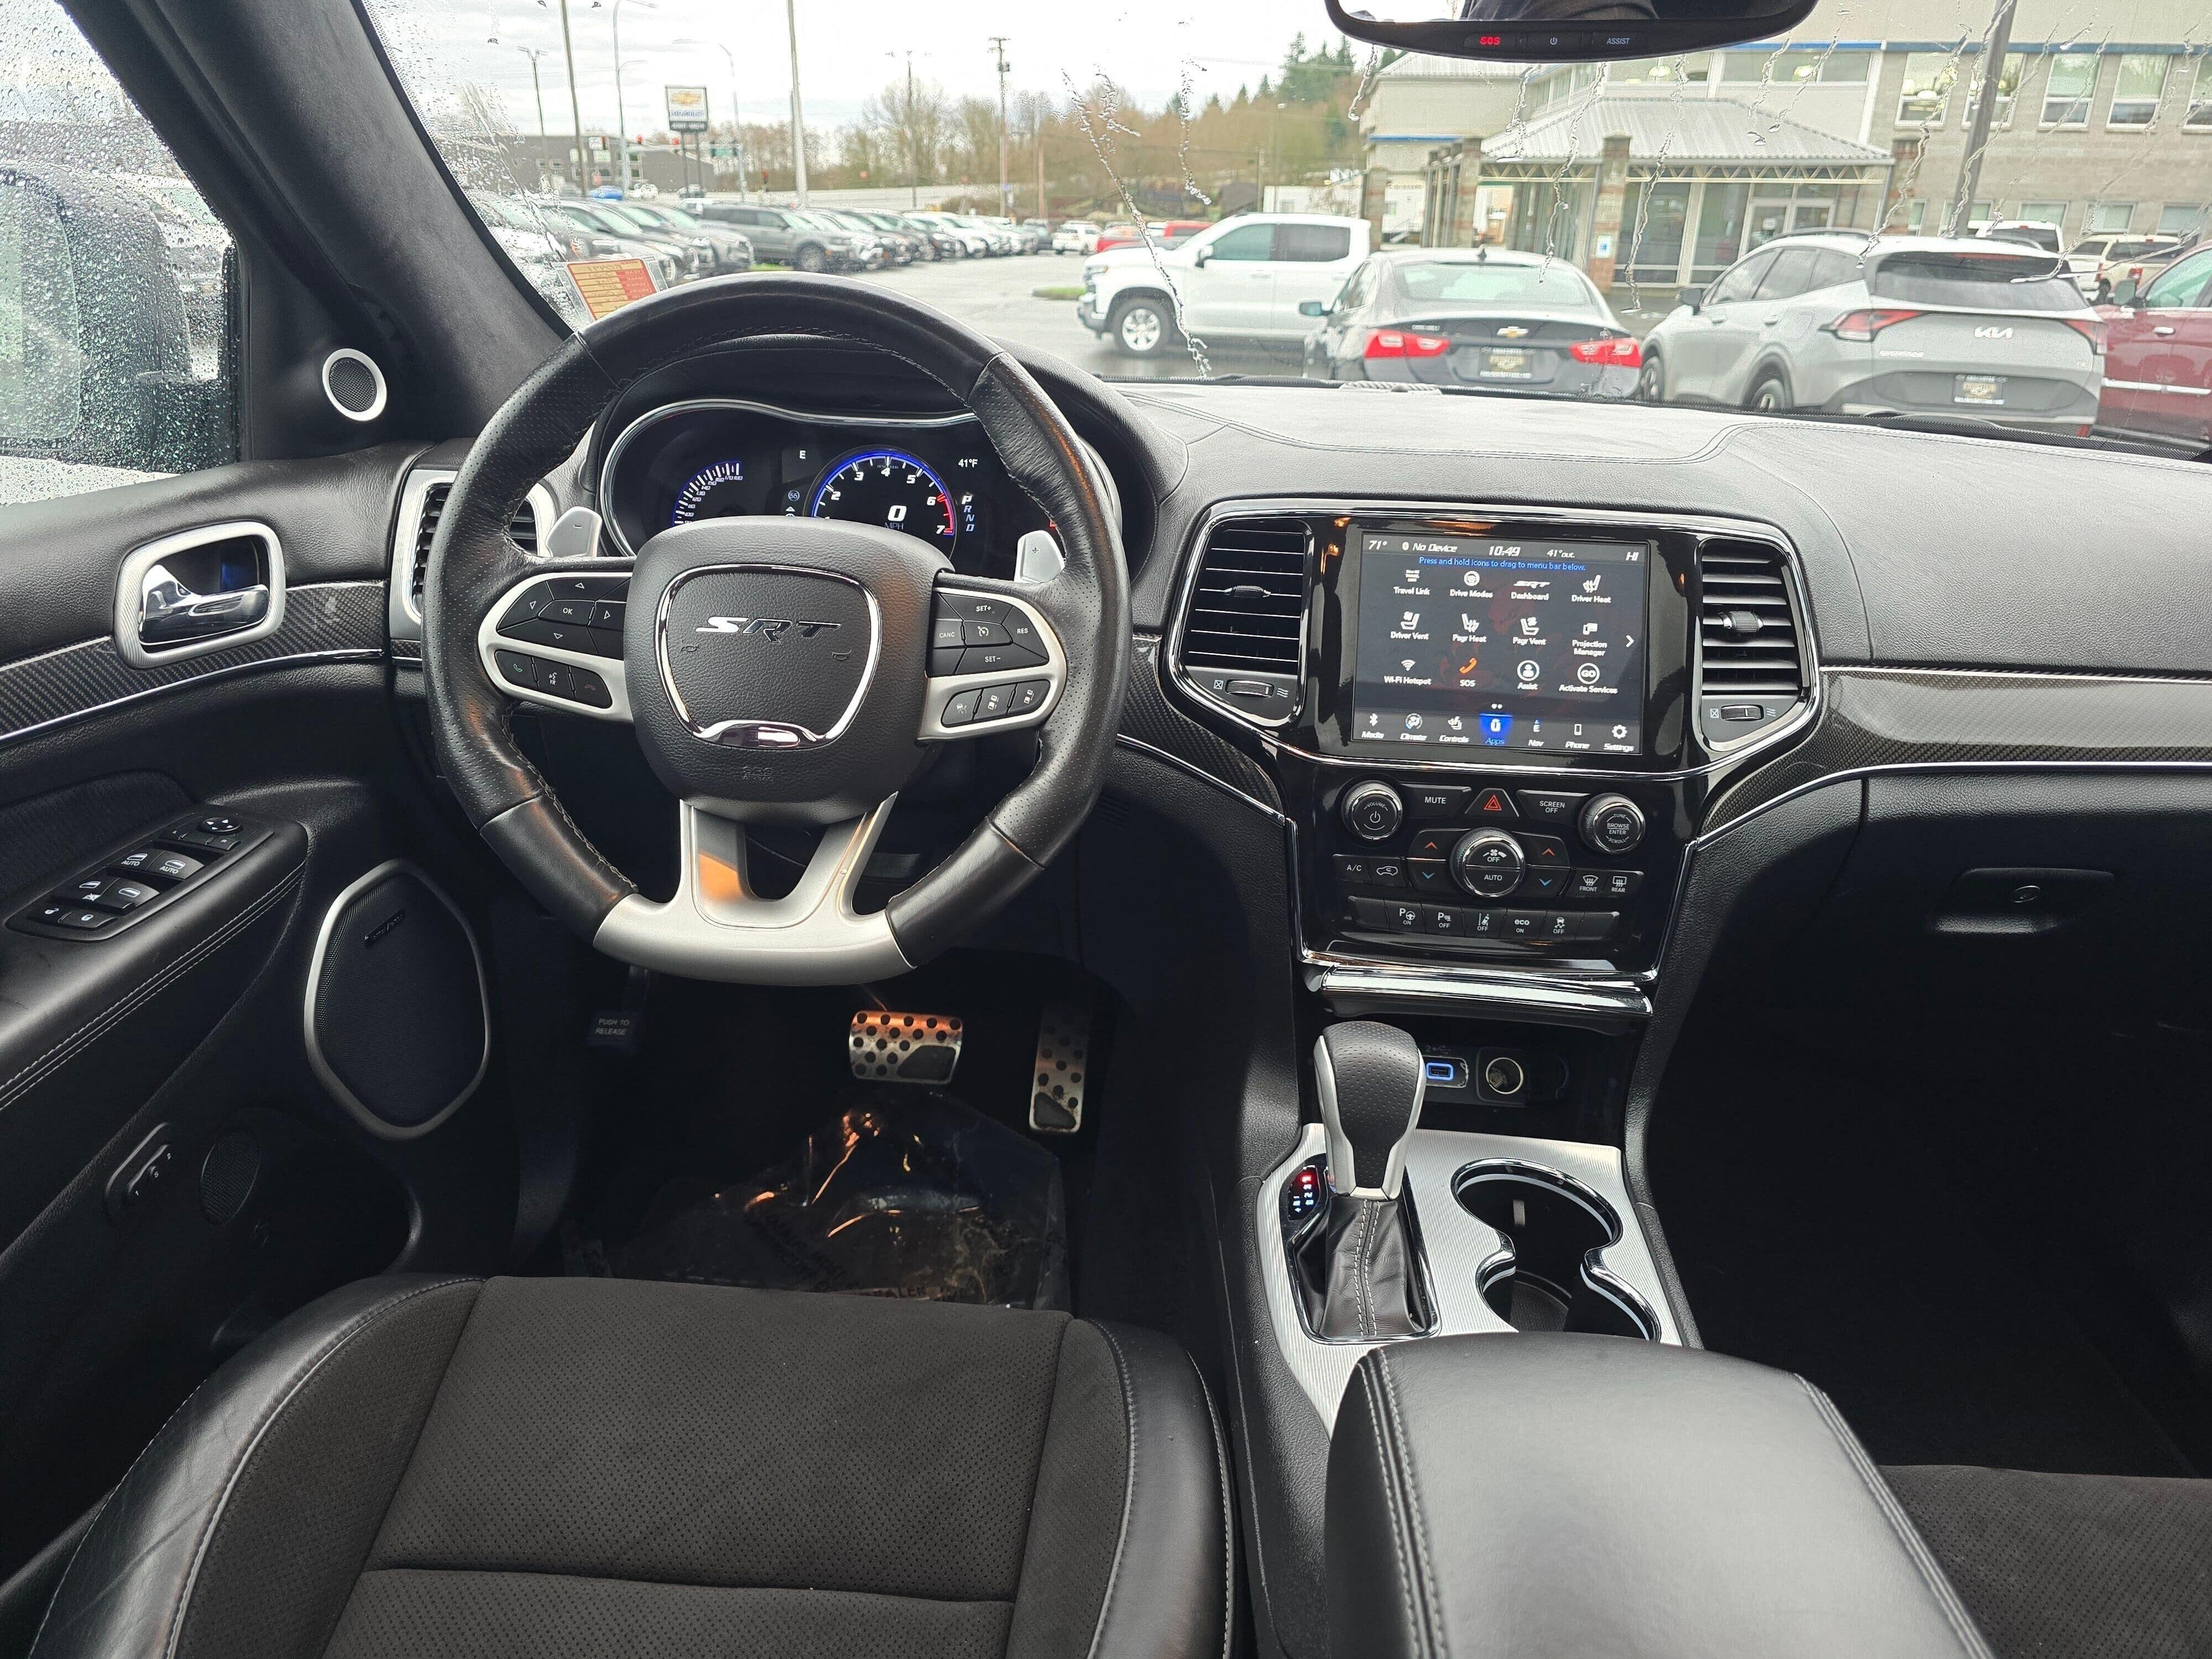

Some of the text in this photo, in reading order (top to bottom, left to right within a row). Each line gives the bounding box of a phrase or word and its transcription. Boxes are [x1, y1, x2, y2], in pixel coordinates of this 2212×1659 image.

[1480, 36, 1500, 45] SOS
[800, 450, 806, 459] E
[958, 459, 978, 467] 41°F
[854, 472, 863, 481] 3
[881, 468, 890, 477] 4
[906, 475, 916, 484] 5
[831, 492, 841, 500] 2
[962, 495, 972, 505] P
[927, 497, 936, 505] 6
[888, 505, 907, 521] 0
[1369, 540, 1387, 550] 71°
[1412, 543, 1458, 552] No Device
[1488, 546, 1521, 556] 10:49
[1626, 551, 1639, 561] HI
[1500, 560, 1516, 569] drag
[1562, 562, 1585, 571] below.
[1394, 586, 1414, 594] Travel
[1450, 589, 1493, 598] Drive Modes
[1511, 592, 1549, 601] Dashboard
[1572, 594, 1592, 603] Driver
[696, 616, 842, 643] SRT
[1390, 631, 1430, 640] Driver Vent
[1452, 634, 1468, 643] Psgr
[1512, 637, 1529, 645] Psgr
[1572, 640, 1607, 648] Projection
[1574, 648, 1605, 657] Manager
[1403, 676, 1432, 686] Hotspot
[1559, 684, 1618, 694] Activate Services
[1361, 731, 1384, 739] Media
[1400, 733, 1427, 741] Climate
[1439, 734, 1469, 743] Controls
[1565, 741, 1590, 749] Phone
[1604, 743, 1635, 752] Settings
[159, 865, 179, 874] AUTO
[1399, 908, 1406, 916] P
[1438, 912, 1444, 921] P
